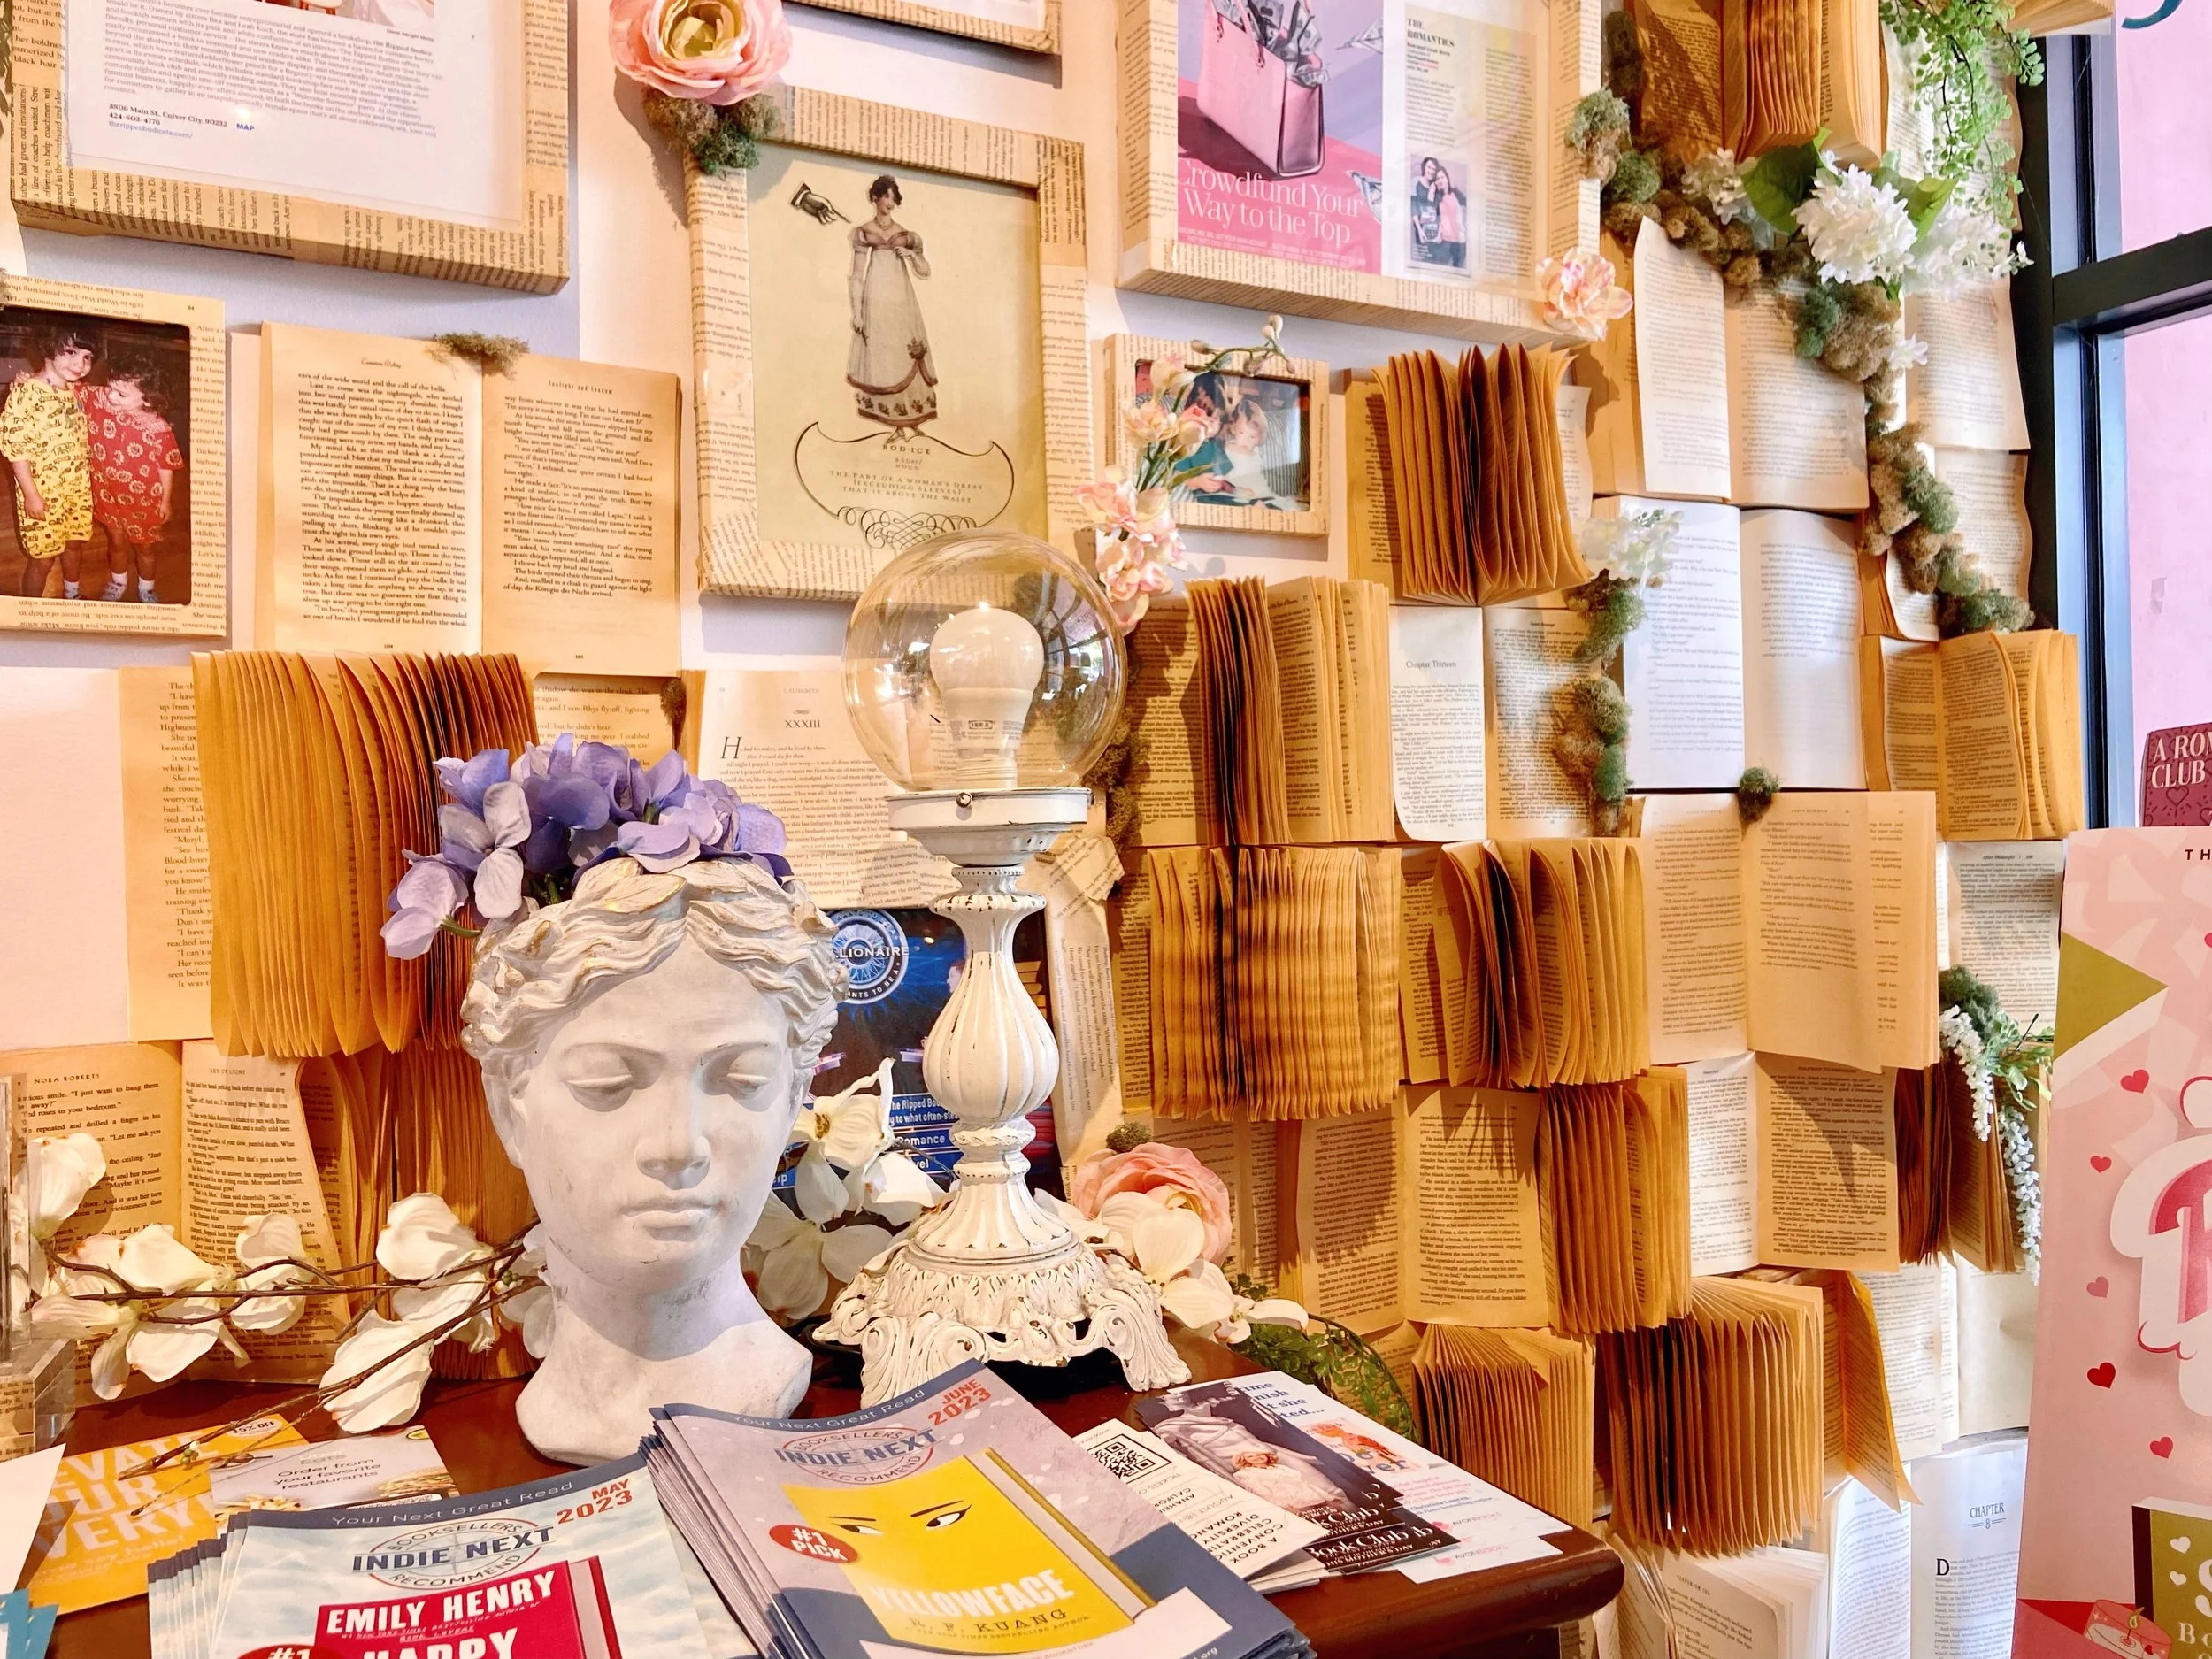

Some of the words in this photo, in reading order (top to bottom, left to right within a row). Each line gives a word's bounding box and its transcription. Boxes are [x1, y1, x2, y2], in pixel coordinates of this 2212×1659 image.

[19, 15, 39, 25] from
[42, 19, 56, 27] the
[1407, 29, 1455, 48] ROMANTICS
[14, 55, 36, 65] black
[40, 59, 57, 69] hair
[130, 105, 149, 115] Main
[163, 111, 186, 122] Culver
[236, 122, 255, 131] MAP
[1310, 184, 1363, 218] Your
[1184, 188, 1236, 229] Way
[1240, 201, 1263, 228] to
[1268, 207, 1306, 236] the
[1308, 211, 1351, 249] Top
[886, 490, 915, 499] ABOVE
[920, 493, 938, 502] THE
[943, 495, 972, 503] WAIST
[1406, 661, 1430, 670] Chapter
[1432, 660, 1457, 669] Thirteen
[785, 718, 821, 729] XXXIII
[2153, 738, 2166, 763] A
[2151, 759, 2206, 788] CLUB
[872, 987, 883, 996] TO
[884, 976, 895, 987] BE
[64, 1073, 100, 1082] ROBERTS
[902, 1097, 926, 1112] Ripped
[895, 1115, 903, 1124] to
[903, 1112, 922, 1124] what
[36, 1125, 65, 1133] repeated
[896, 1134, 945, 1147] Romance
[942, 1379, 982, 1405] JUNE
[733, 1415, 771, 1427] Your
[779, 1420, 821, 1430] Next
[826, 1411, 877, 1427] Great
[881, 1389, 926, 1414] Read
[927, 1386, 992, 1426] 2023
[1279, 1398, 1308, 1407] she
[773, 1448, 852, 1466] INDIE
[864, 1428, 939, 1461] NEXT
[794, 1431, 903, 1451] BOOKSELLERS
[273, 1475, 313, 1486] your
[317, 1463, 381, 1478] favorite
[278, 1465, 328, 1477] Order
[334, 1459, 375, 1469] from
[816, 1455, 921, 1482] RECOMMEND
[282, 1471, 379, 1490] restaurants
[591, 1479, 631, 1499] MAY
[333, 1515, 380, 1526] Your
[392, 1509, 442, 1523] Next
[452, 1497, 512, 1516] Great
[519, 1481, 573, 1503] Read
[556, 1489, 633, 1525] 2023
[1970, 1502, 2004, 1518] CHAPTER
[1327, 1507, 1380, 1527] Club
[1985, 1518, 1991, 1529] 8
[387, 1522, 523, 1551] BOOKSELLERS
[792, 1526, 827, 1546] #1
[1202, 1513, 1260, 1545] DIVERSITY
[1356, 1530, 1409, 1548] Club
[352, 1548, 450, 1571] INDIE
[466, 1526, 555, 1559] NEXT
[790, 1539, 849, 1561] PICK
[1228, 1541, 1268, 1564] BOOK
[389, 1555, 521, 1586] RECOMMEND
[326, 1601, 426, 1634] EMILY
[442, 1571, 556, 1620] HENRY
[870, 1569, 1075, 1617] YELLOWFACE
[975, 1609, 1068, 1632] KUANG
